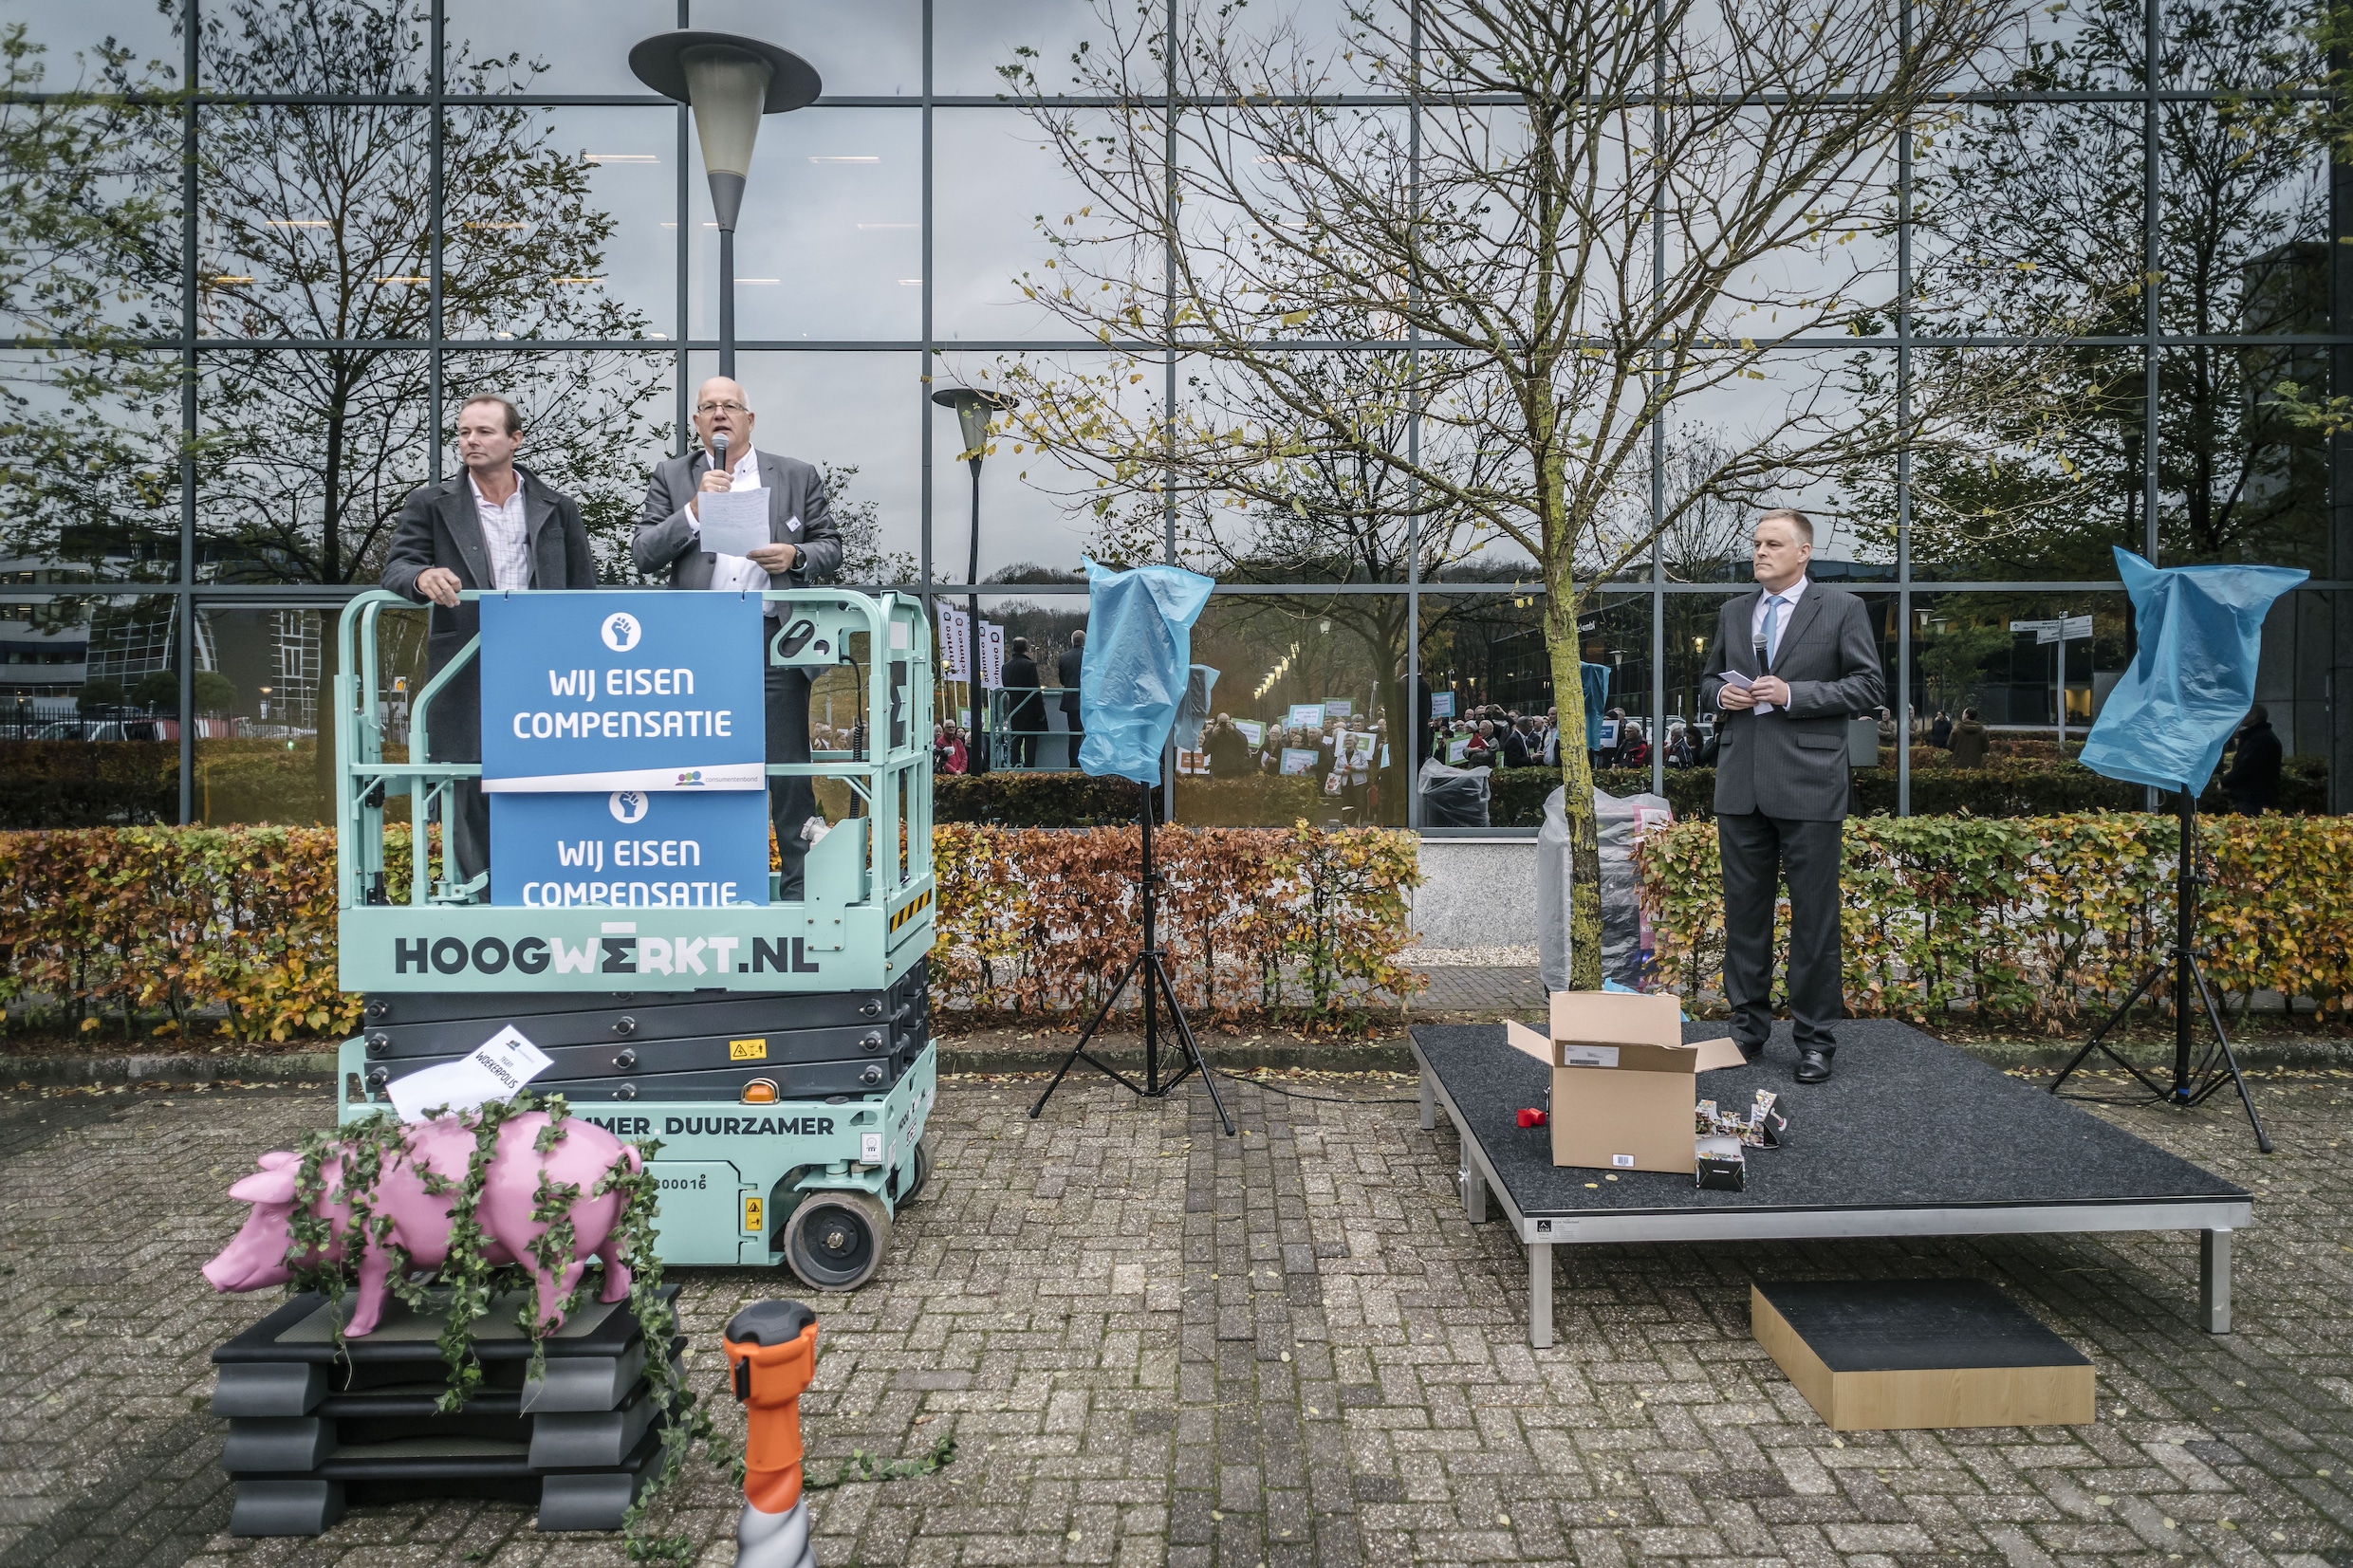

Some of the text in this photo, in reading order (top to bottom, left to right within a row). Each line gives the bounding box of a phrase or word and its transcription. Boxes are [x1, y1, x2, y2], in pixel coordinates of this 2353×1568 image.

[946, 626, 954, 668] chmea
[548, 668, 695, 702] WIJ EISEN
[512, 710, 732, 739] COMPENSATIE
[557, 839, 700, 873] WIJ EISEN
[522, 881, 737, 907] COMPENSATIE
[474, 1051, 519, 1089] WOEKERPOLIS
[499, 1056, 514, 1068] TEGEN
[665, 1116, 834, 1135] DUURZAMER
